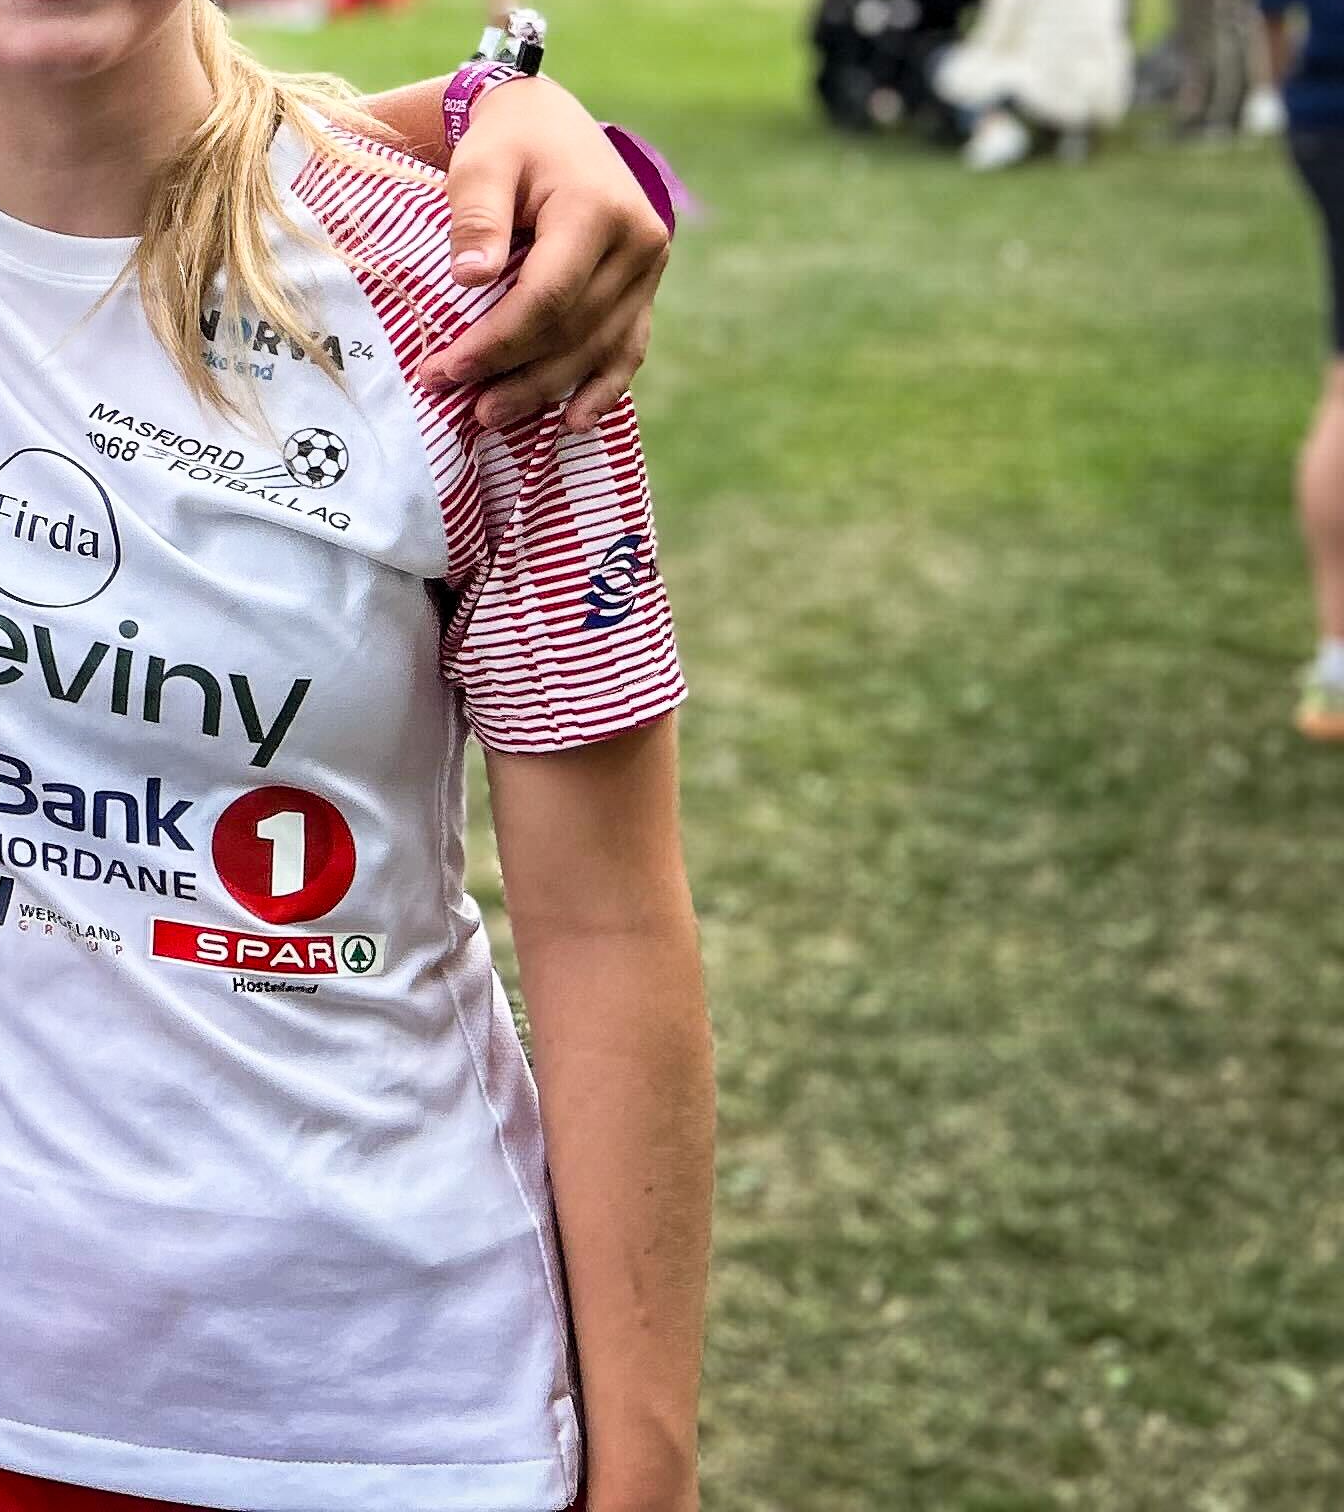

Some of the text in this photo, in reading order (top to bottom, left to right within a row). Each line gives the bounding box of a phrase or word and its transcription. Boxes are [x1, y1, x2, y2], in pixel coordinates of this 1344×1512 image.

[89, 402, 245, 471] MASFJORD
[256, 810, 306, 898] 1
[195, 932, 334, 970] SPAR
